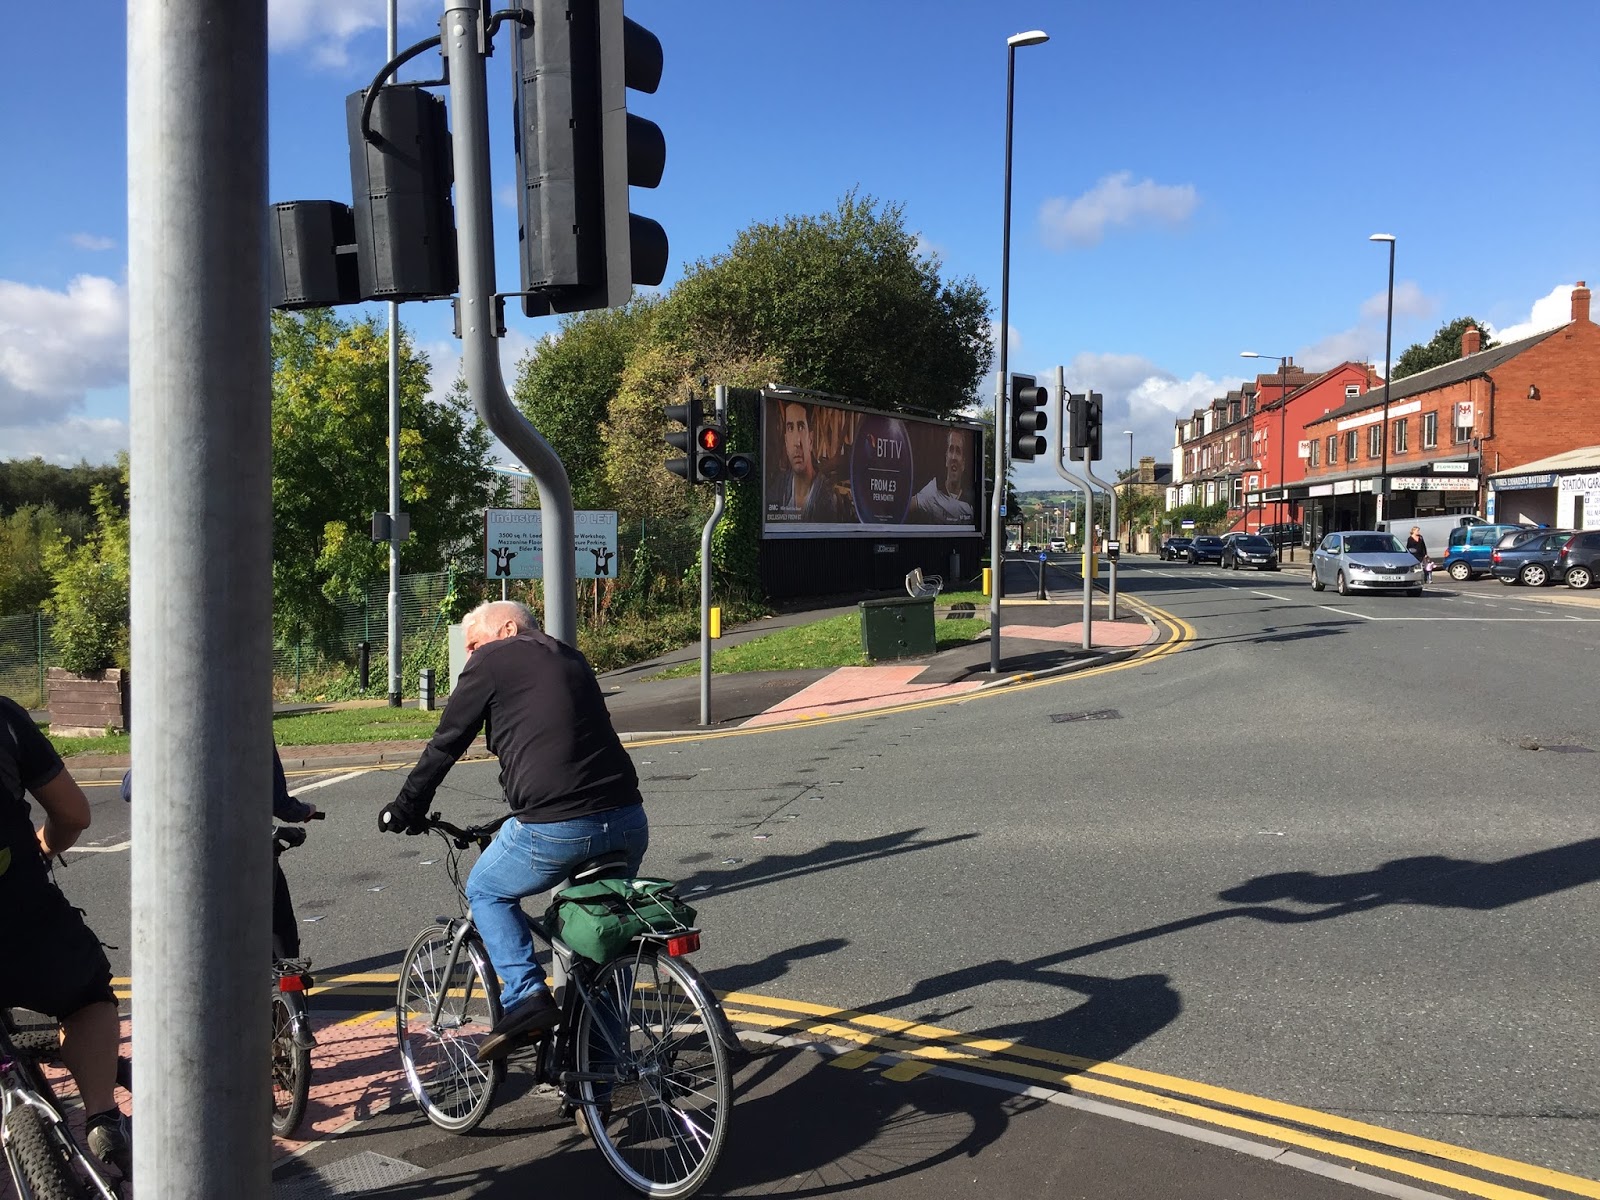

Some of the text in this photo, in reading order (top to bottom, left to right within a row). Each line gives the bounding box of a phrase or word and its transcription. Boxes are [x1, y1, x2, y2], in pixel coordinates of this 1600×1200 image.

[877, 438, 902, 459] BT TV
[871, 479, 896, 492] FROM £3
[1529, 474, 1551, 484] BATTERIES
[1562, 477, 1600, 490] STATION GAR
[491, 512, 542, 523] Industria
[590, 514, 613, 524] LET
